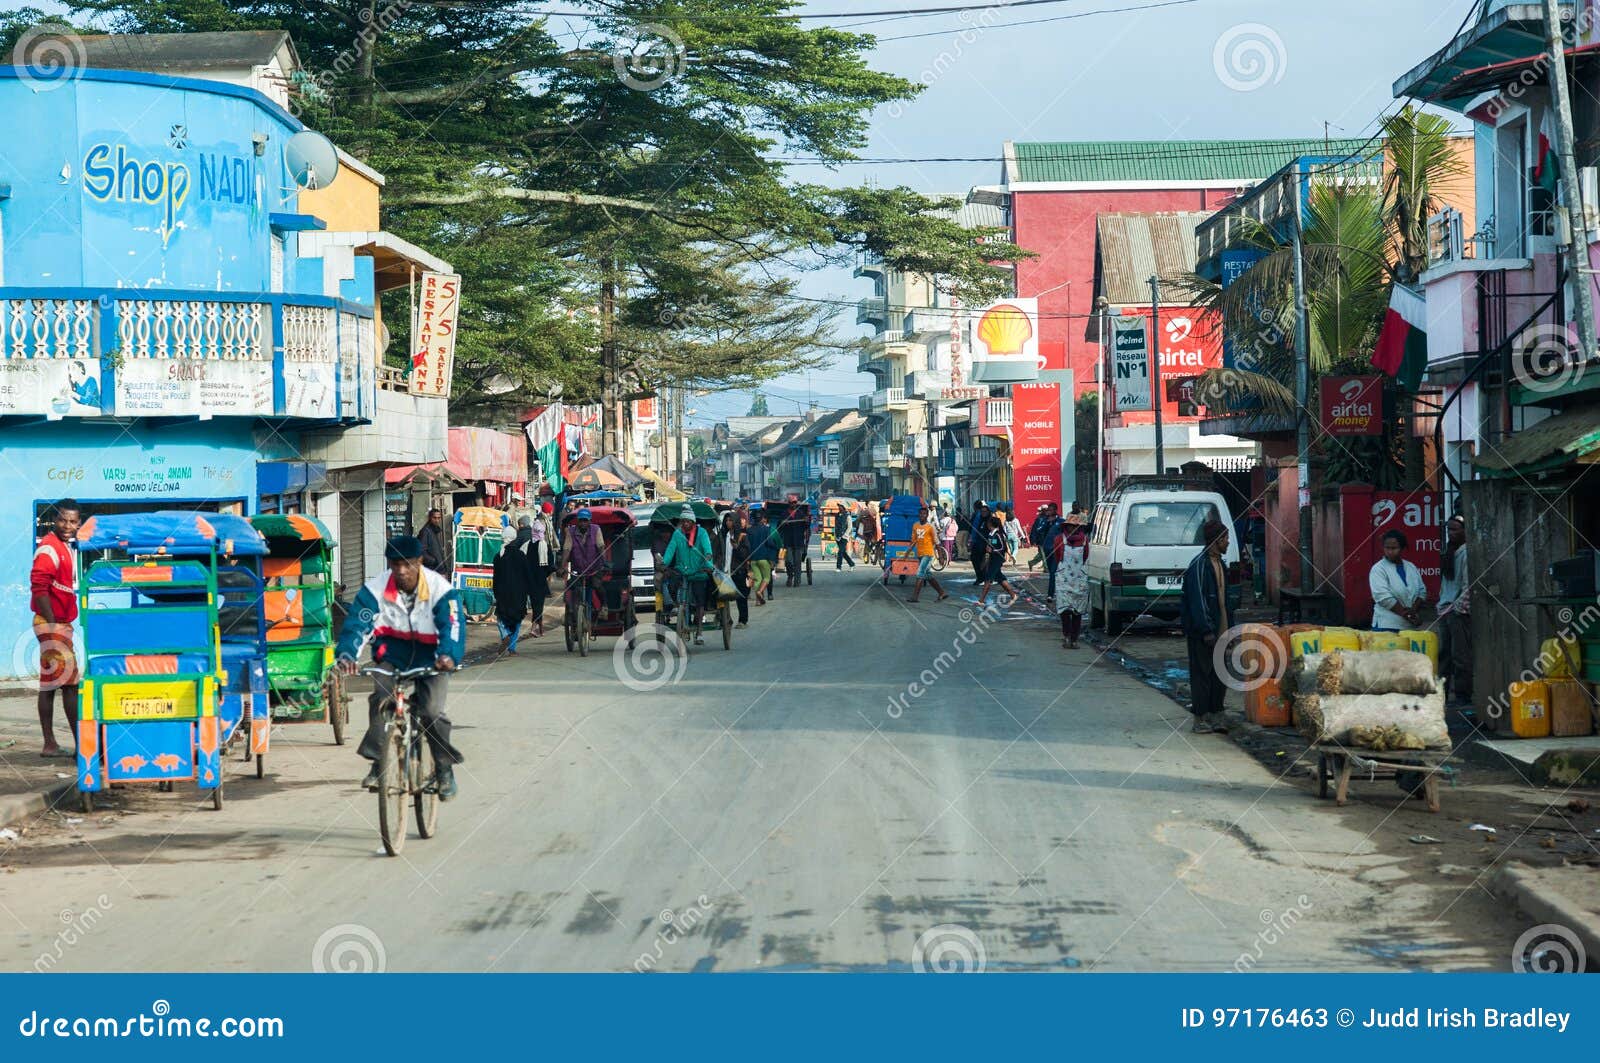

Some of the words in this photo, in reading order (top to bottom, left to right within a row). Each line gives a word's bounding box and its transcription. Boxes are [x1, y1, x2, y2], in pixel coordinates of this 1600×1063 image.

[83, 143, 191, 247] Shop
[1224, 261, 1257, 270] RESTA
[436, 281, 456, 337] 5/5
[1116, 350, 1147, 361] Réseau
[1158, 347, 1204, 367] airtel
[435, 346, 447, 393] SAFIDY
[1117, 361, 1147, 379] N°1
[941, 387, 986, 399] HOTEL
[1331, 402, 1373, 417] airtel
[1024, 421, 1054, 429] MOBILE
[1335, 416, 1370, 427] money
[1020, 447, 1058, 455] INTERNET
[47, 466, 85, 487] Café
[103, 467, 126, 480] VARY
[115, 482, 146, 492] RONONO
[149, 481, 180, 492] VELONA
[155, 702, 173, 714] CUM
